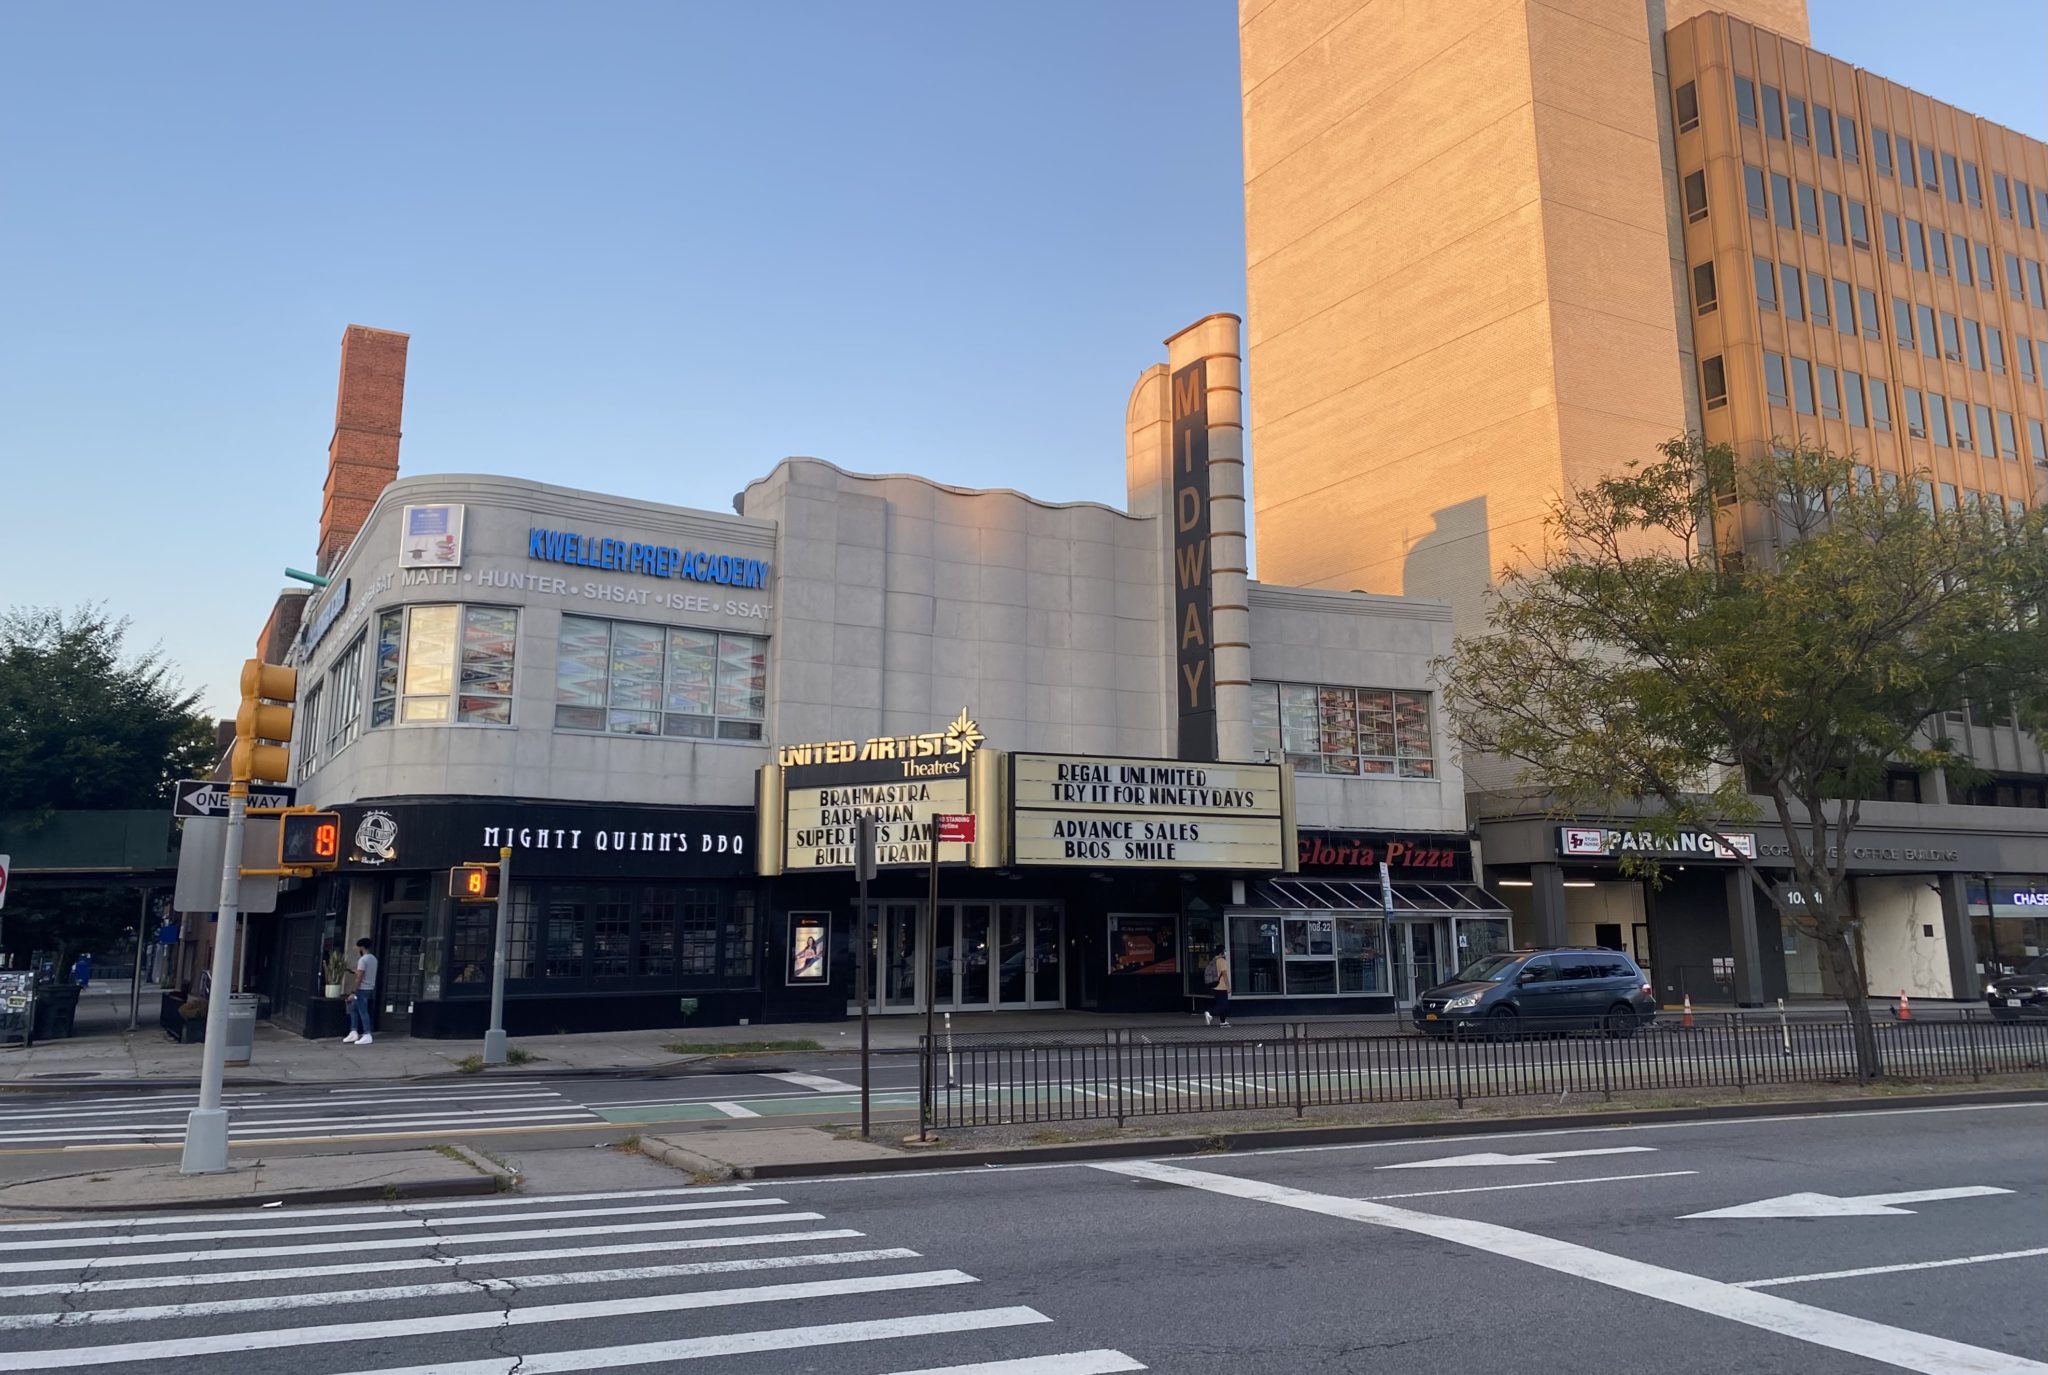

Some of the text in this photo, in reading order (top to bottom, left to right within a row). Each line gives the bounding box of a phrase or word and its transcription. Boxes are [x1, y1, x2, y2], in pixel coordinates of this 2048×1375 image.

[1174, 367, 1207, 708] MIDWAY
[529, 527, 769, 589] KWELLER PREP ACADEMY
[402, 568, 457, 586] MATH
[478, 569, 568, 596] HUNTER
[583, 582, 651, 605] SHSAT
[666, 593, 709, 612] ISEE
[725, 600, 773, 620] SSAT
[779, 732, 962, 766] UNITED ARTISTS
[902, 759, 960, 777] Theatres
[1058, 763, 1206, 787] REGAL UNLIMITED
[196, 793, 281, 808] ONE WAY
[820, 784, 930, 806] BRAHMASTRA
[1051, 783, 1254, 808] TRY IT FOR NINETY DAYS
[821, 804, 913, 826] BARBARIAN
[316, 825, 335, 856] 19
[483, 827, 743, 854] MIGHTY QUINN'S BBQ
[796, 828, 845, 847] SUPER
[1053, 820, 1199, 841] ADVANCE SALES
[1608, 831, 1714, 852] PARKING
[877, 844, 927, 862] TRAIN
[1064, 841, 1176, 860] BROS SMILE
[1298, 838, 1454, 868] Gloria Pizza
[1904, 848, 1960, 862] BUILDING
[470, 873, 481, 892] 19
[2013, 893, 2048, 906] CHASE
